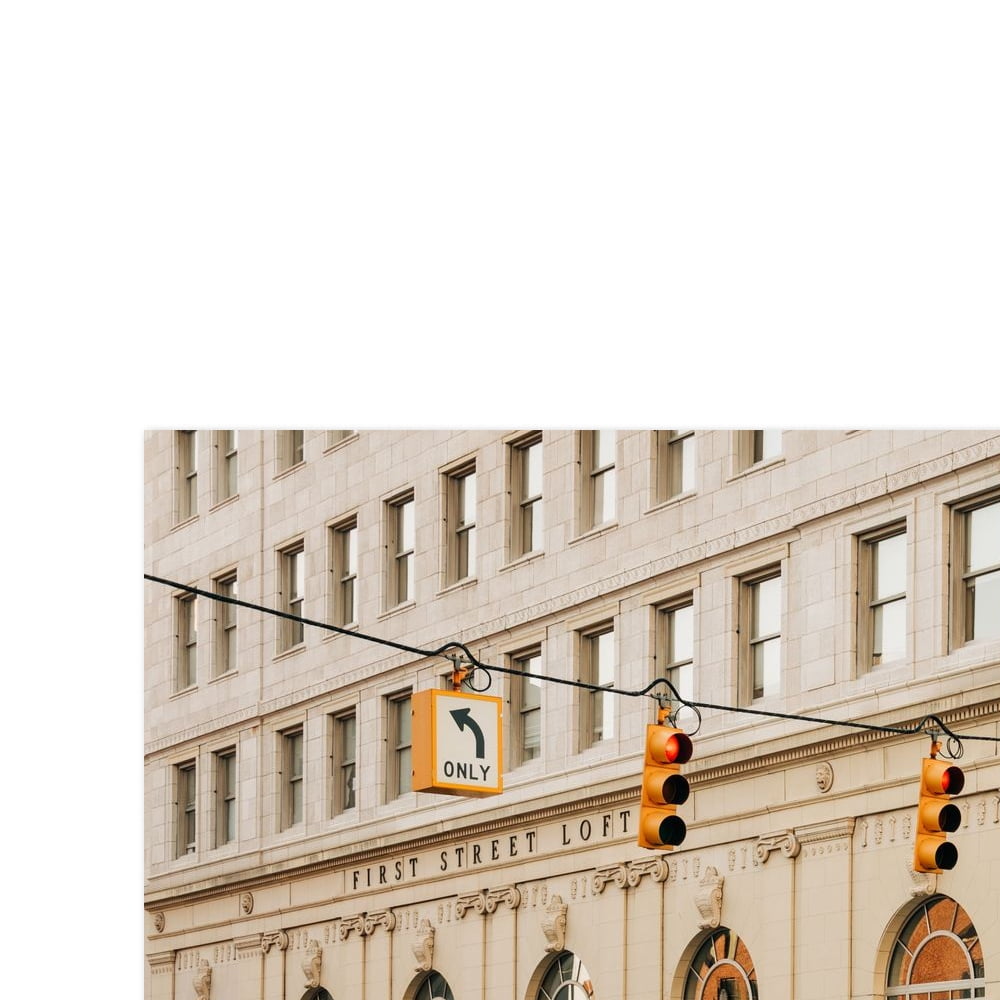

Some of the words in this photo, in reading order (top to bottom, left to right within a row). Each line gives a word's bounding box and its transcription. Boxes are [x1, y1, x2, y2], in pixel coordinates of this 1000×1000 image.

[444, 761, 490, 781] ONLY
[352, 857, 418, 890] FIRST
[440, 831, 535, 871] STREET
[562, 810, 630, 845] LOFT
